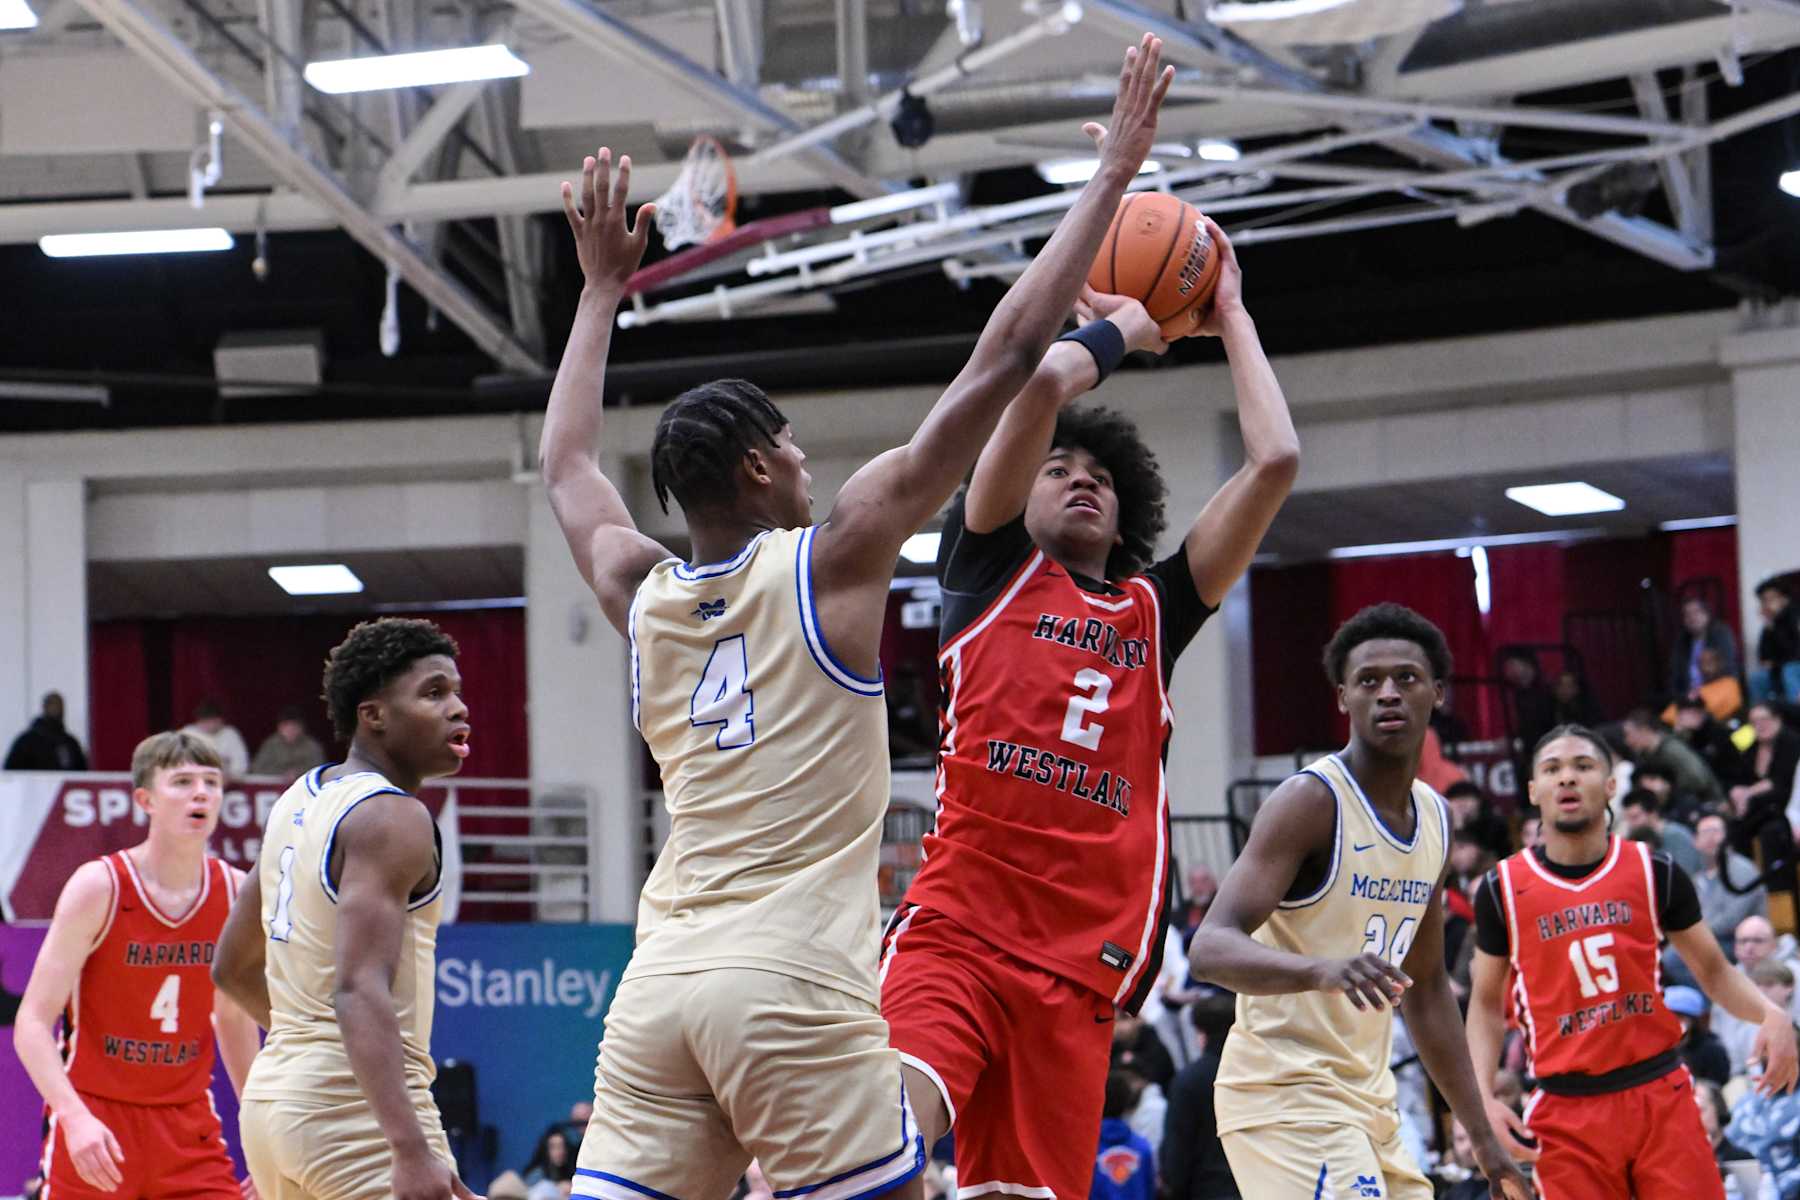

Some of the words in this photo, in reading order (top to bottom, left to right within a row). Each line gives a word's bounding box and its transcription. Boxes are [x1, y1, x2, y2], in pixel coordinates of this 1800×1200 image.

[690, 633, 755, 750] 4
[1060, 667, 1112, 752] 2
[986, 739, 1132, 818] WESTLAK
[270, 845, 294, 943] 1
[1536, 900, 1631, 941] HARVARD
[437, 957, 611, 1018] Stanley
[1568, 932, 1619, 998] 15
[150, 974, 180, 1033] 4
